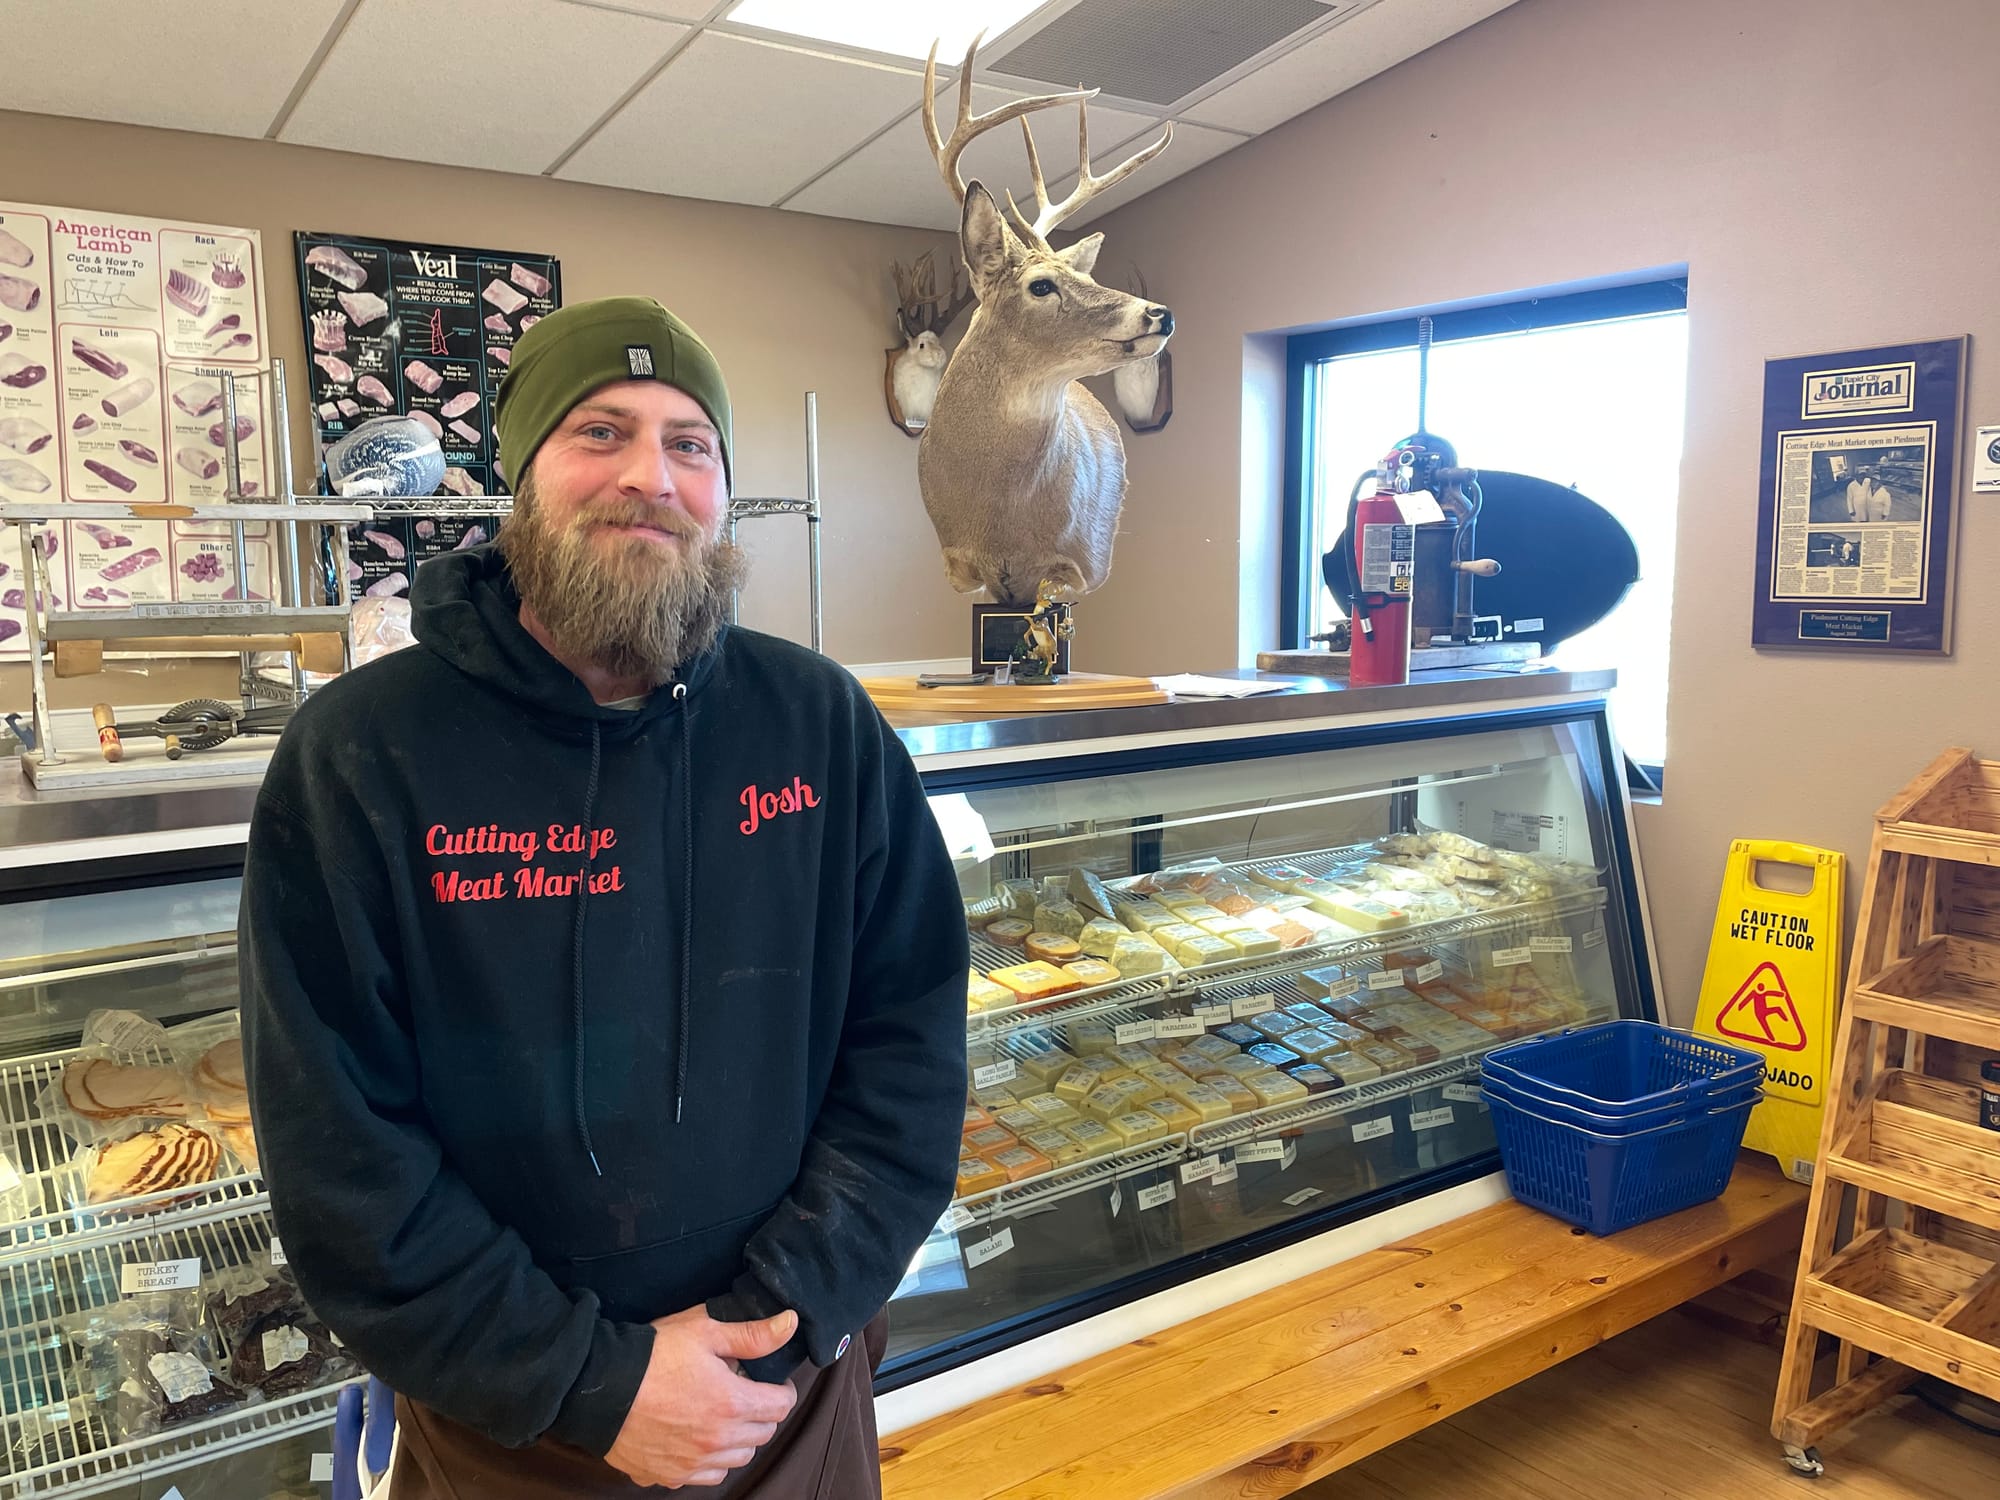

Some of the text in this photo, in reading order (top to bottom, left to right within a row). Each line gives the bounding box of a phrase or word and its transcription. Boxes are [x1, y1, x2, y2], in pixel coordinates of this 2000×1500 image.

[55, 219, 152, 242] American
[77, 236, 132, 254] Lamb
[195, 235, 216, 245] Rack
[67, 254, 144, 268] Cuts & How To
[409, 250, 458, 279] Veal
[76, 264, 136, 277] Cook Them
[417, 280, 437, 288] RETAIL
[396, 286, 419, 294] WHERE
[420, 288, 435, 296] THEY
[436, 289, 455, 297] COME
[1844, 374, 1880, 385] Rapid City
[1814, 374, 1901, 401] Journal
[328, 421, 343, 430] RIB
[1810, 441, 1826, 449] Edge
[1828, 440, 1843, 448] Meat
[1844, 438, 1866, 447] Market
[445, 452, 476, 462] OUND)
[200, 543, 223, 552] Other
[739, 776, 821, 835] Josh
[425, 824, 540, 862] Cutting
[431, 871, 508, 903] Meat
[1741, 909, 1808, 933] CAUTION
[1731, 923, 1814, 951] WET FLOOR
[1162, 1022, 1198, 1032] PARMESAN
[979, 1239, 1003, 1257] SALAMI
[137, 1264, 179, 1276] TURKEY
[138, 1276, 178, 1288] BREAST
